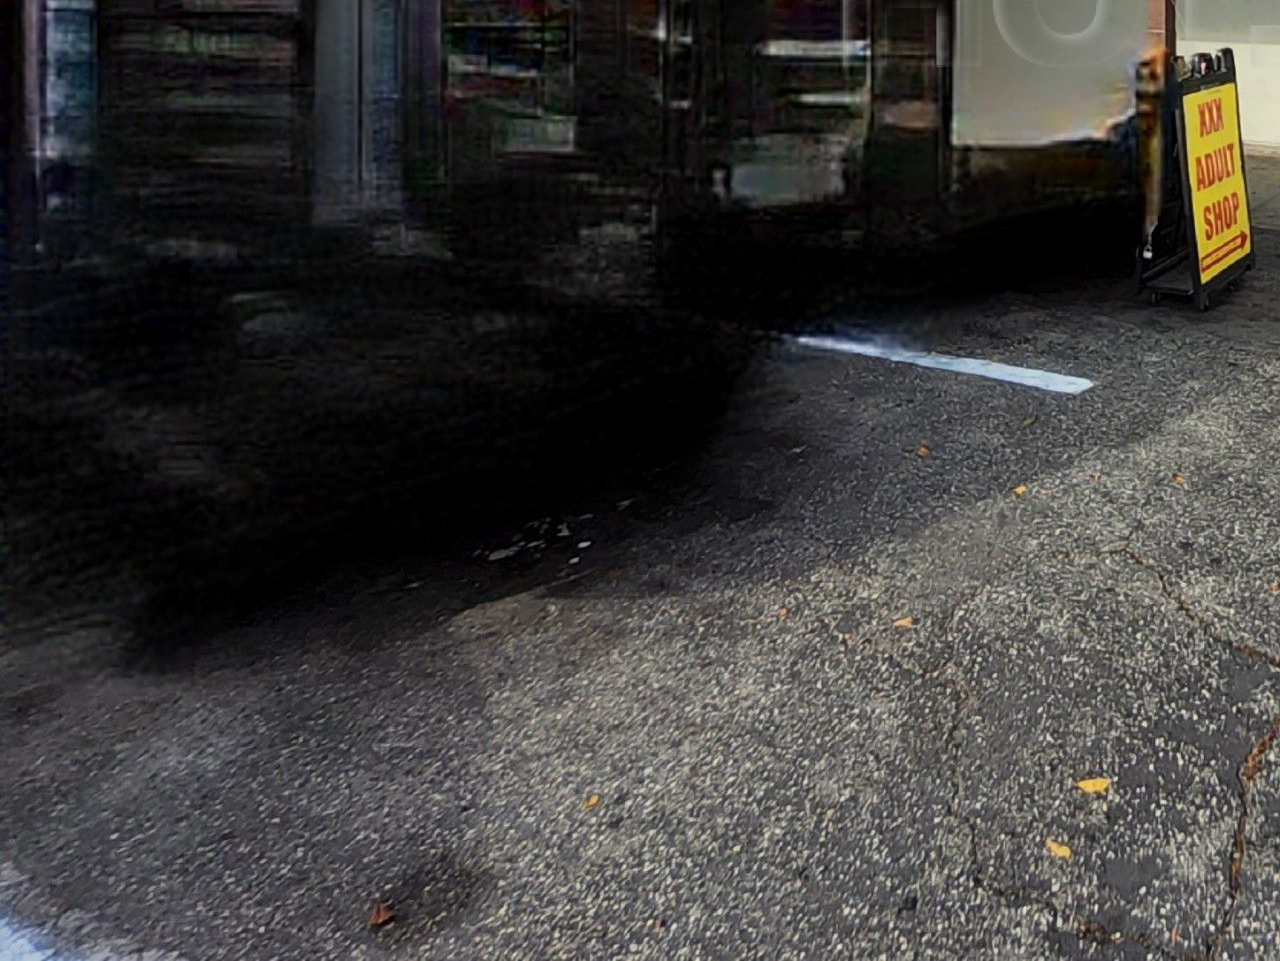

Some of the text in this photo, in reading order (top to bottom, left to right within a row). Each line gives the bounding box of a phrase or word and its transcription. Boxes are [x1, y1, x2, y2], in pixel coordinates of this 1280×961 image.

[1197, 97, 1225, 138] XXX
[1195, 143, 1236, 192] ADULT
[1204, 191, 1240, 241] SHOP
